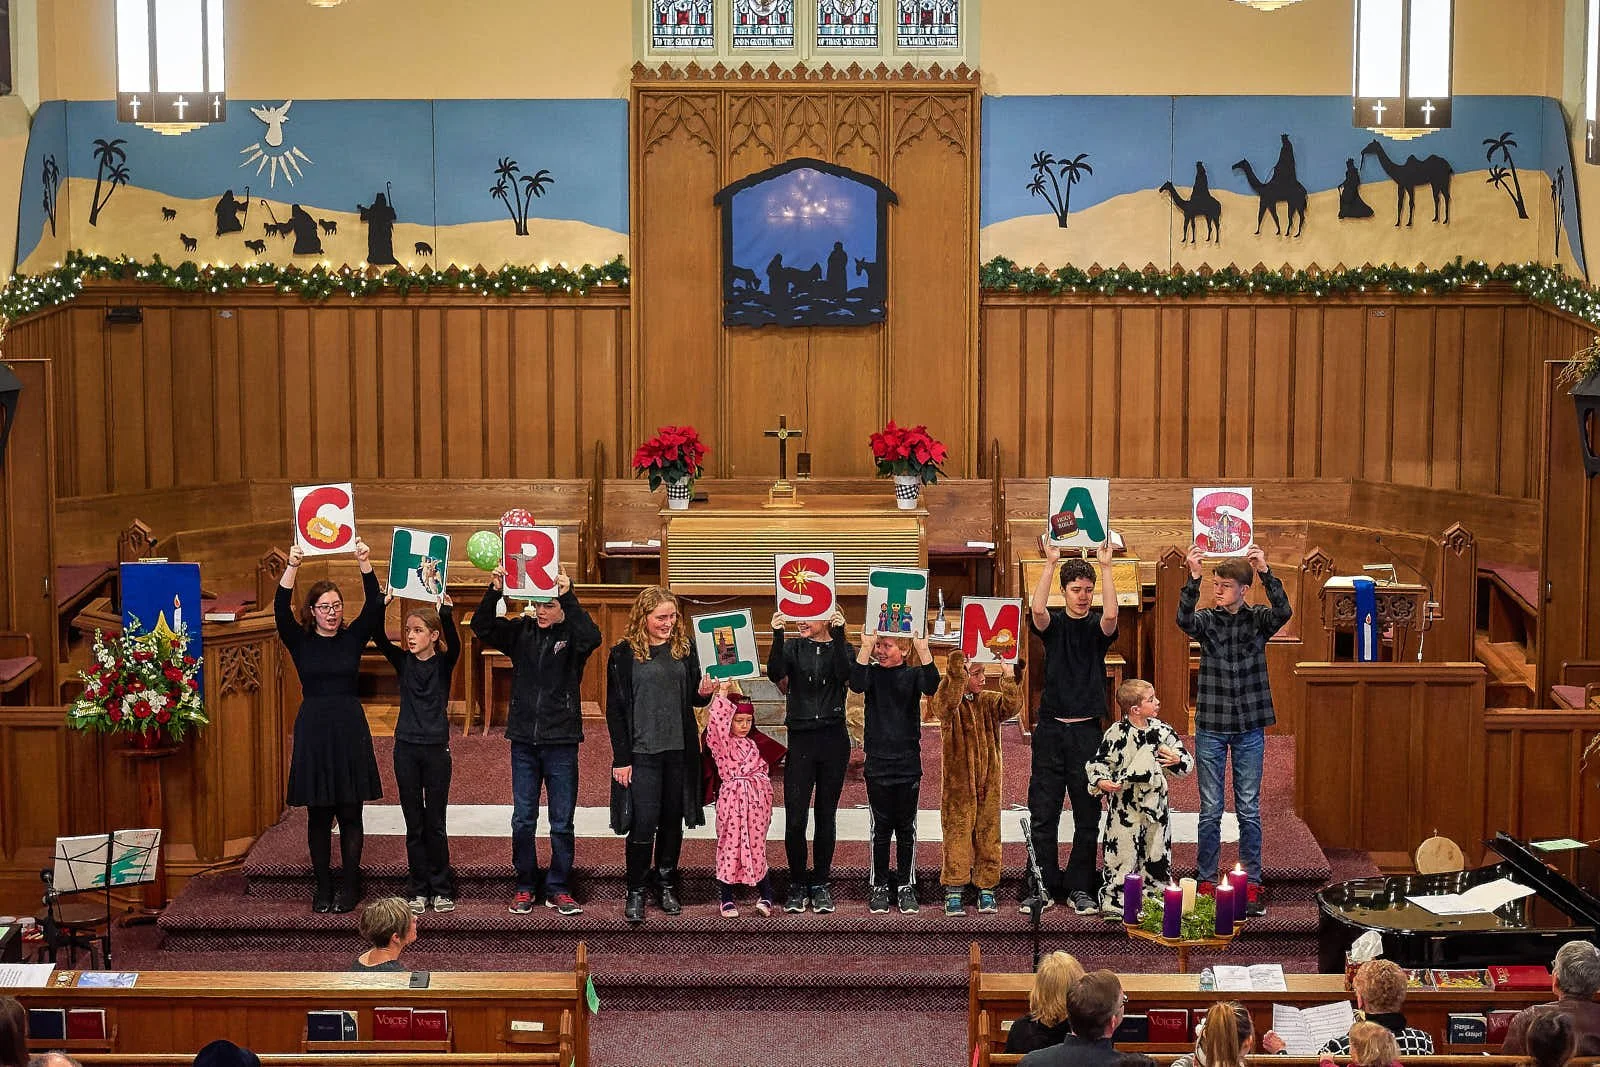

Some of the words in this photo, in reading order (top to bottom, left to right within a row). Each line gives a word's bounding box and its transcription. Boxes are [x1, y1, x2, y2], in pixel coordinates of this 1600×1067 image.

[701, 38, 713, 46] GOD
[297, 486, 353, 550] C
[1050, 486, 1106, 543] A
[1195, 491, 1252, 554] S
[389, 529, 449, 595] H
[503, 529, 555, 590] R
[778, 557, 833, 618] S
[869, 571, 926, 633] T
[963, 603, 1021, 660] M
[697, 613, 754, 679] I
[376, 1014, 409, 1025] VOICES
[1149, 1015, 1183, 1026] VOICES
